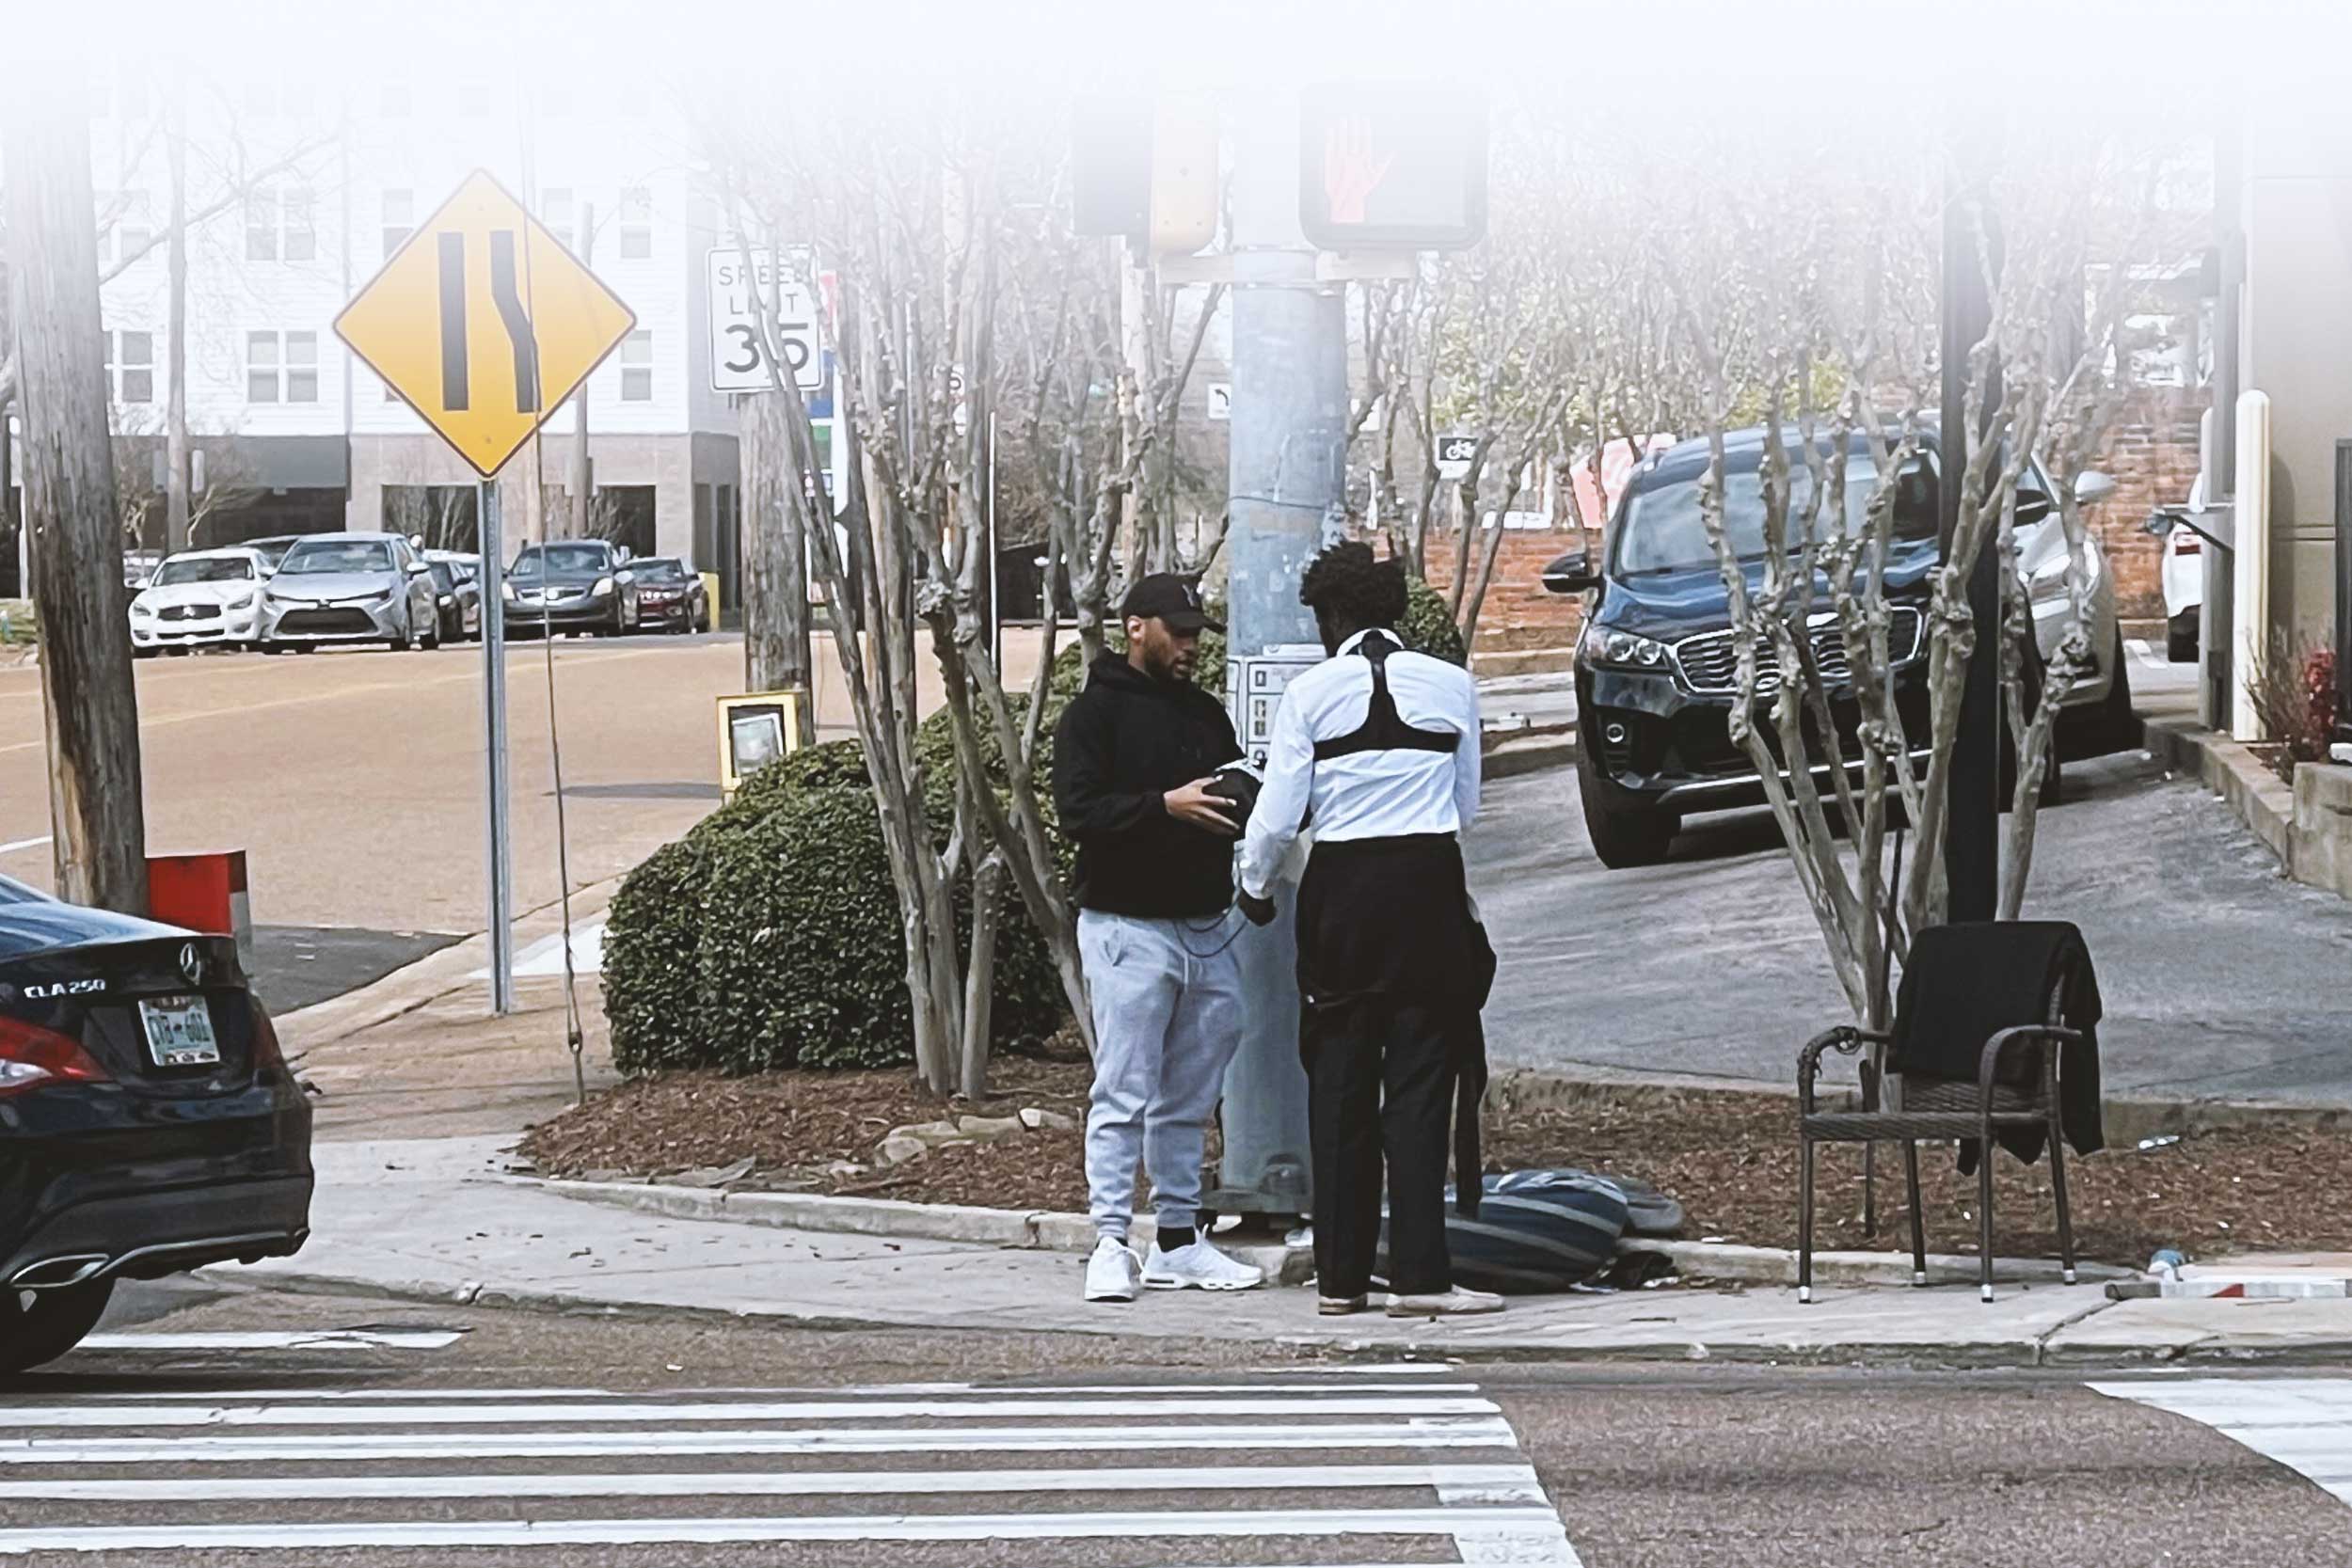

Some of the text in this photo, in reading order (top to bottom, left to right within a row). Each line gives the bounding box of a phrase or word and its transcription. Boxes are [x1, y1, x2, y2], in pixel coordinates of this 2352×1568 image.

[729, 293, 799, 315] LIIT
[723, 323, 809, 373] 35
[24, 979, 105, 998] CLA 250
